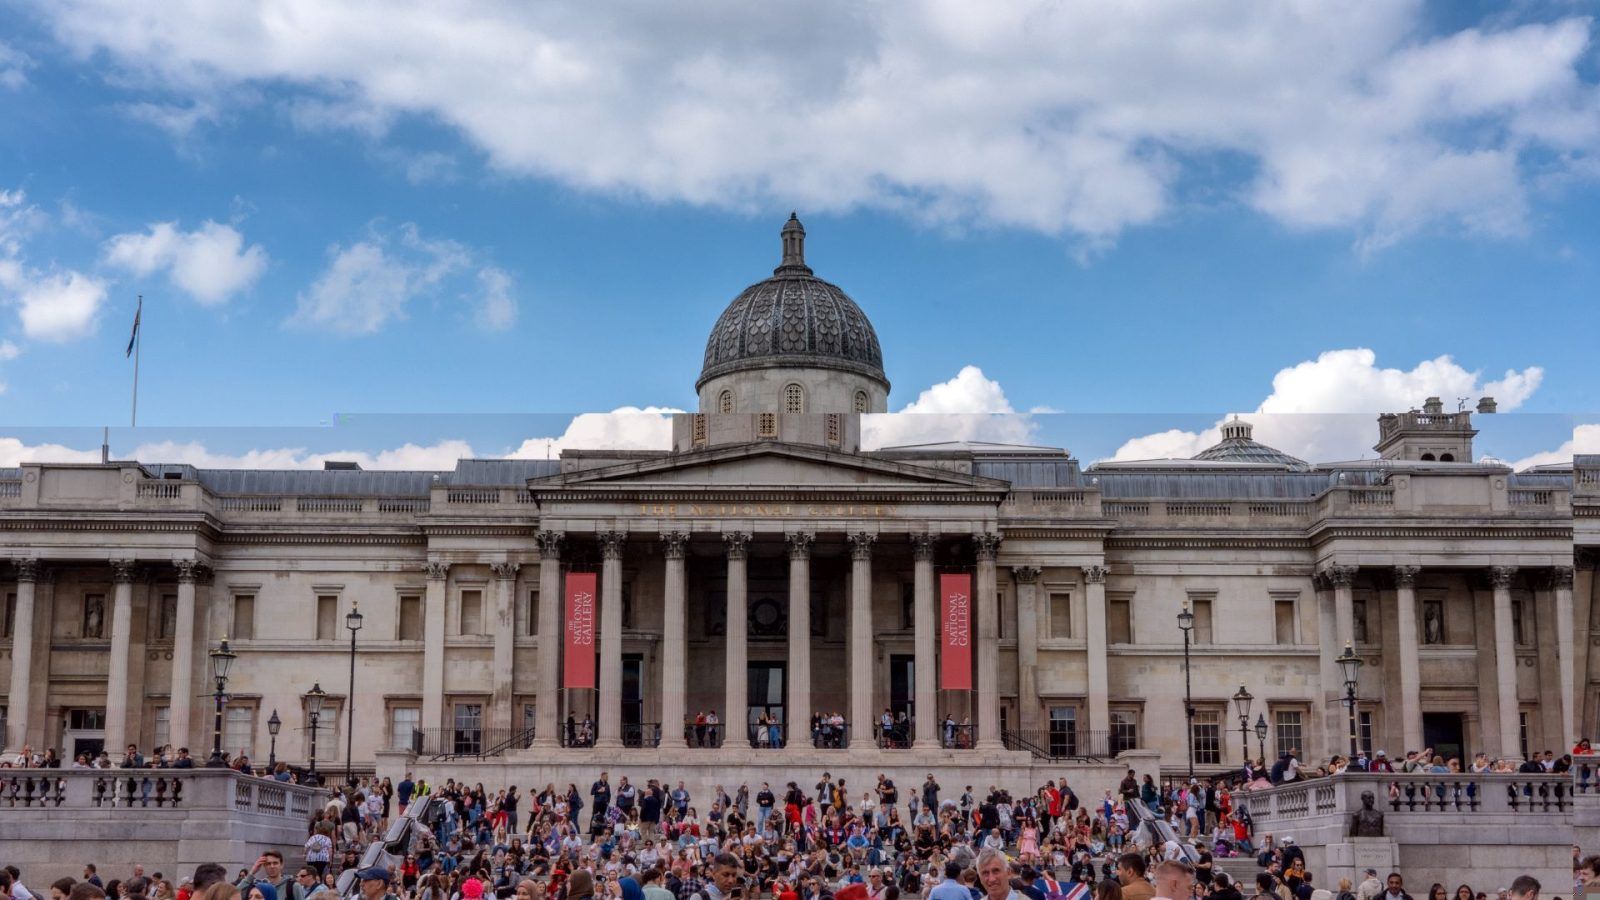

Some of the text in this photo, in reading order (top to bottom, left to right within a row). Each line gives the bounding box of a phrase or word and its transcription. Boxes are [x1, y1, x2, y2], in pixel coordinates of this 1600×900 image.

[574, 592, 582, 645] NATIONAL
[582, 591, 592, 645] GALLERY
[950, 592, 958, 646] NATIONAL
[958, 592, 968, 646] GALLERY
